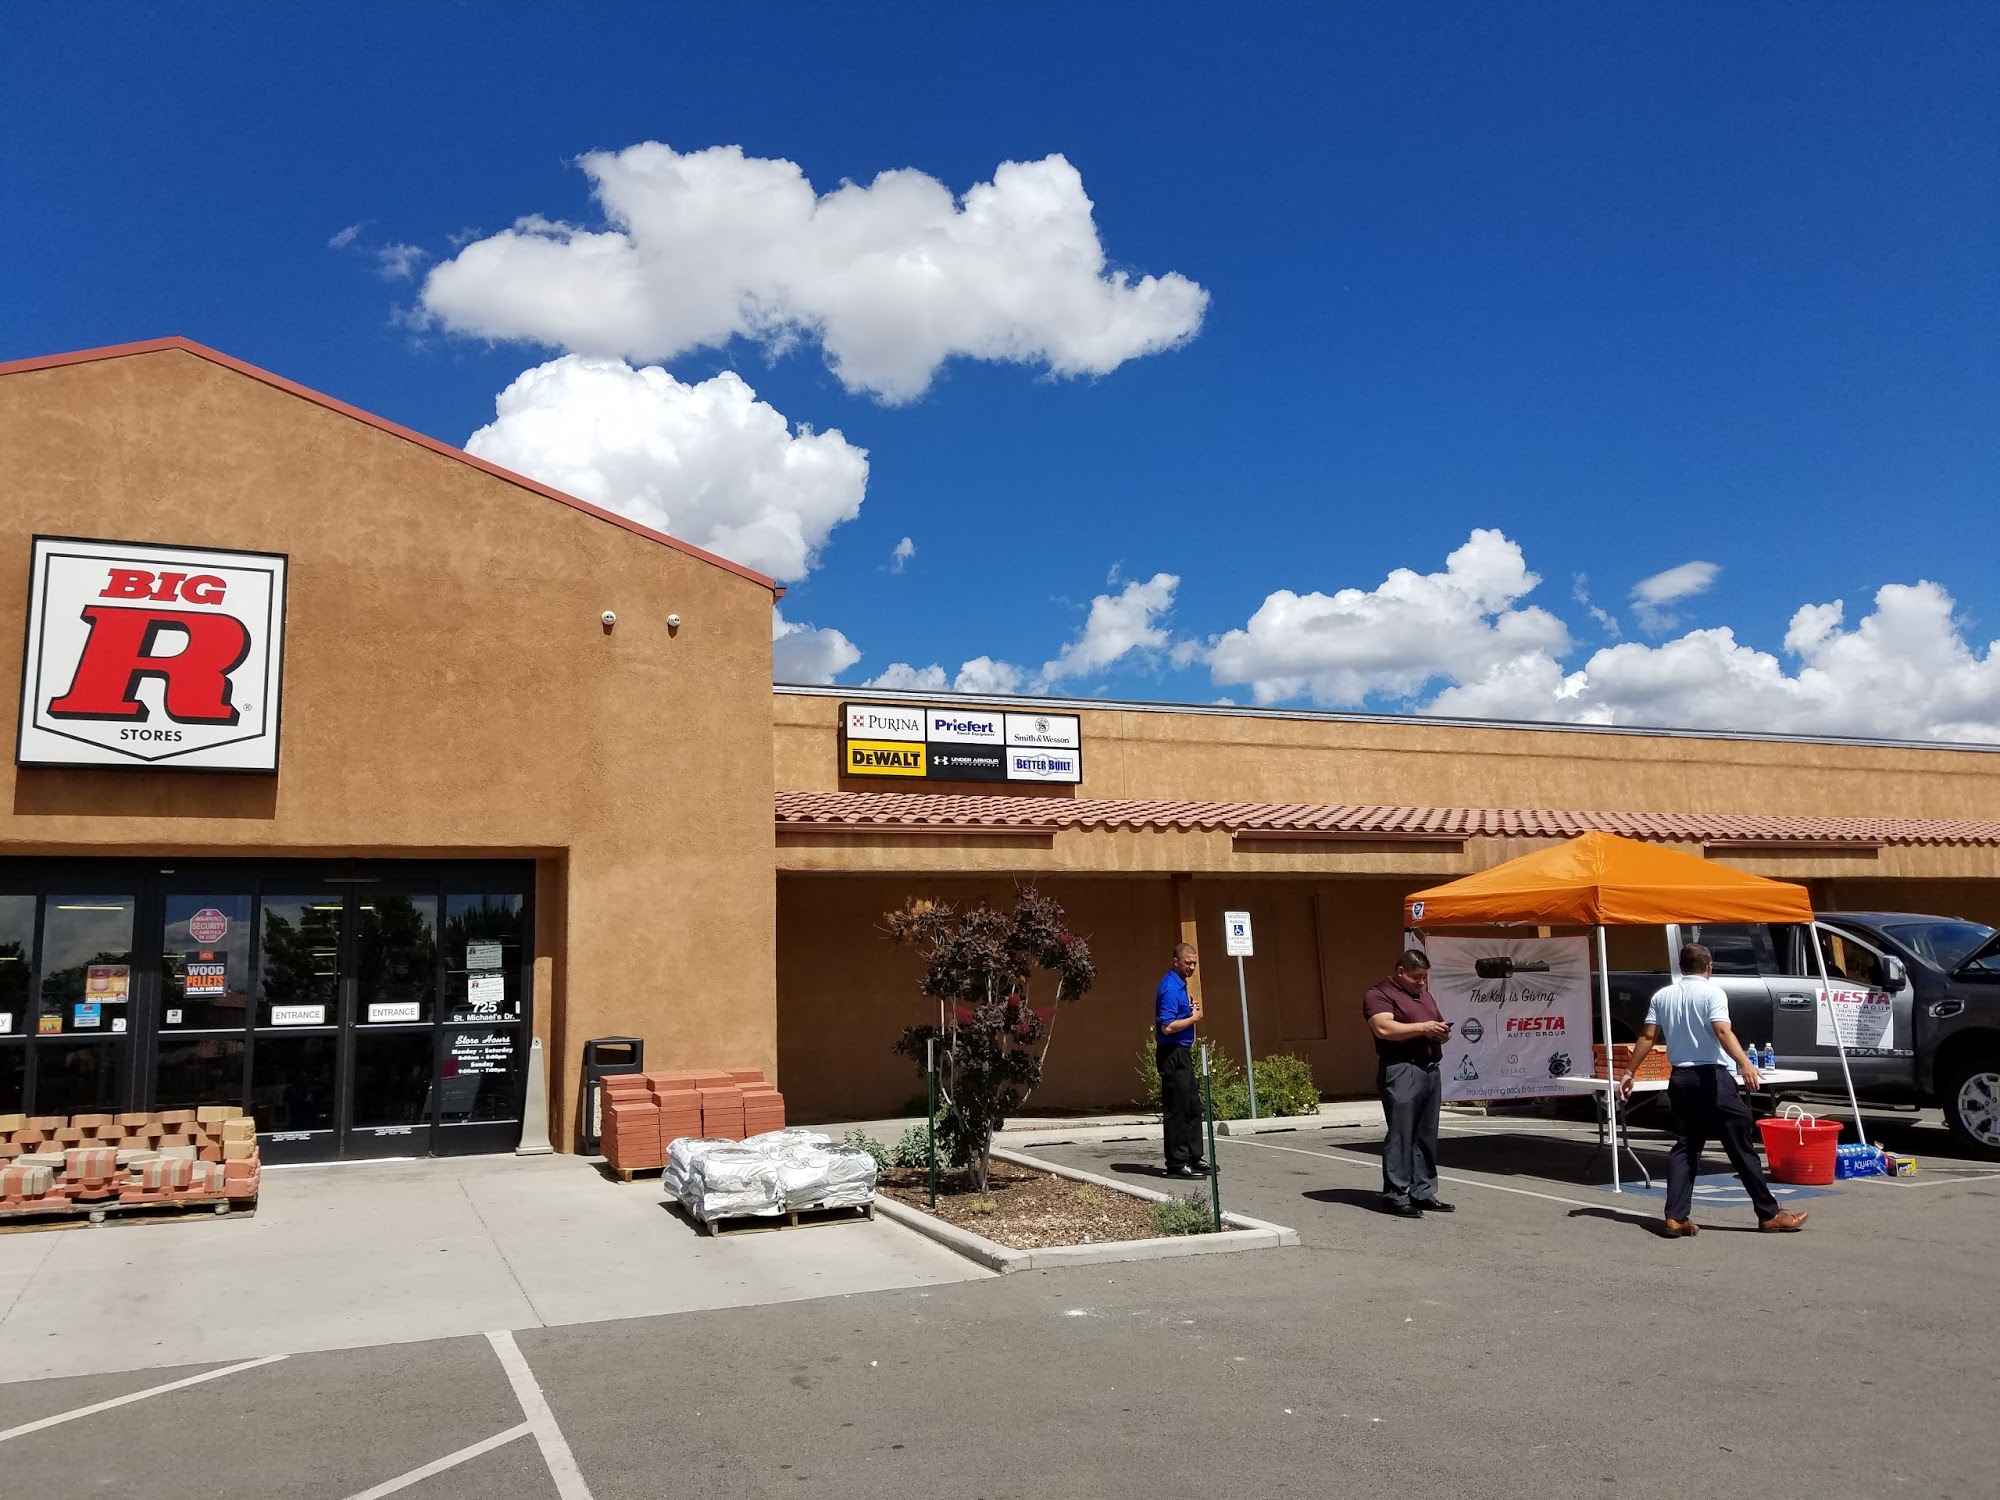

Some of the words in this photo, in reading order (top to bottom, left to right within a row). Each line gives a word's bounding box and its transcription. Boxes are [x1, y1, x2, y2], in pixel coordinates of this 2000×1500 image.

[99, 568, 227, 605] BIG
[47, 605, 251, 726] R
[869, 715, 919, 732] PURINA
[935, 718, 993, 733] Priefert
[120, 728, 182, 742] STORES
[1016, 759, 1047, 771] BETTER
[1049, 760, 1072, 772] BUILT
[192, 922, 225, 930] SECURITY
[188, 966, 224, 976] WOOD
[186, 975, 224, 987] PELLETS
[1470, 989, 1487, 1003] The
[1489, 989, 1505, 1009] Key
[1509, 993, 1518, 1002] is
[1521, 988, 1556, 1008] Giving
[372, 1008, 416, 1017] ENTRANCE
[472, 1002, 498, 1014] 725
[1855, 1003, 1891, 1011] GROUP
[276, 1010, 321, 1019] ENTRANCE
[466, 1013, 502, 1021] Michael's
[1506, 1017, 1565, 1032] FIESTA
[455, 1034, 480, 1045] Store
[481, 1034, 511, 1044] Hours
[1466, 1088, 1487, 1097] Proudly
[1488, 1087, 1505, 1096] giving
[1506, 1086, 1519, 1094] back
